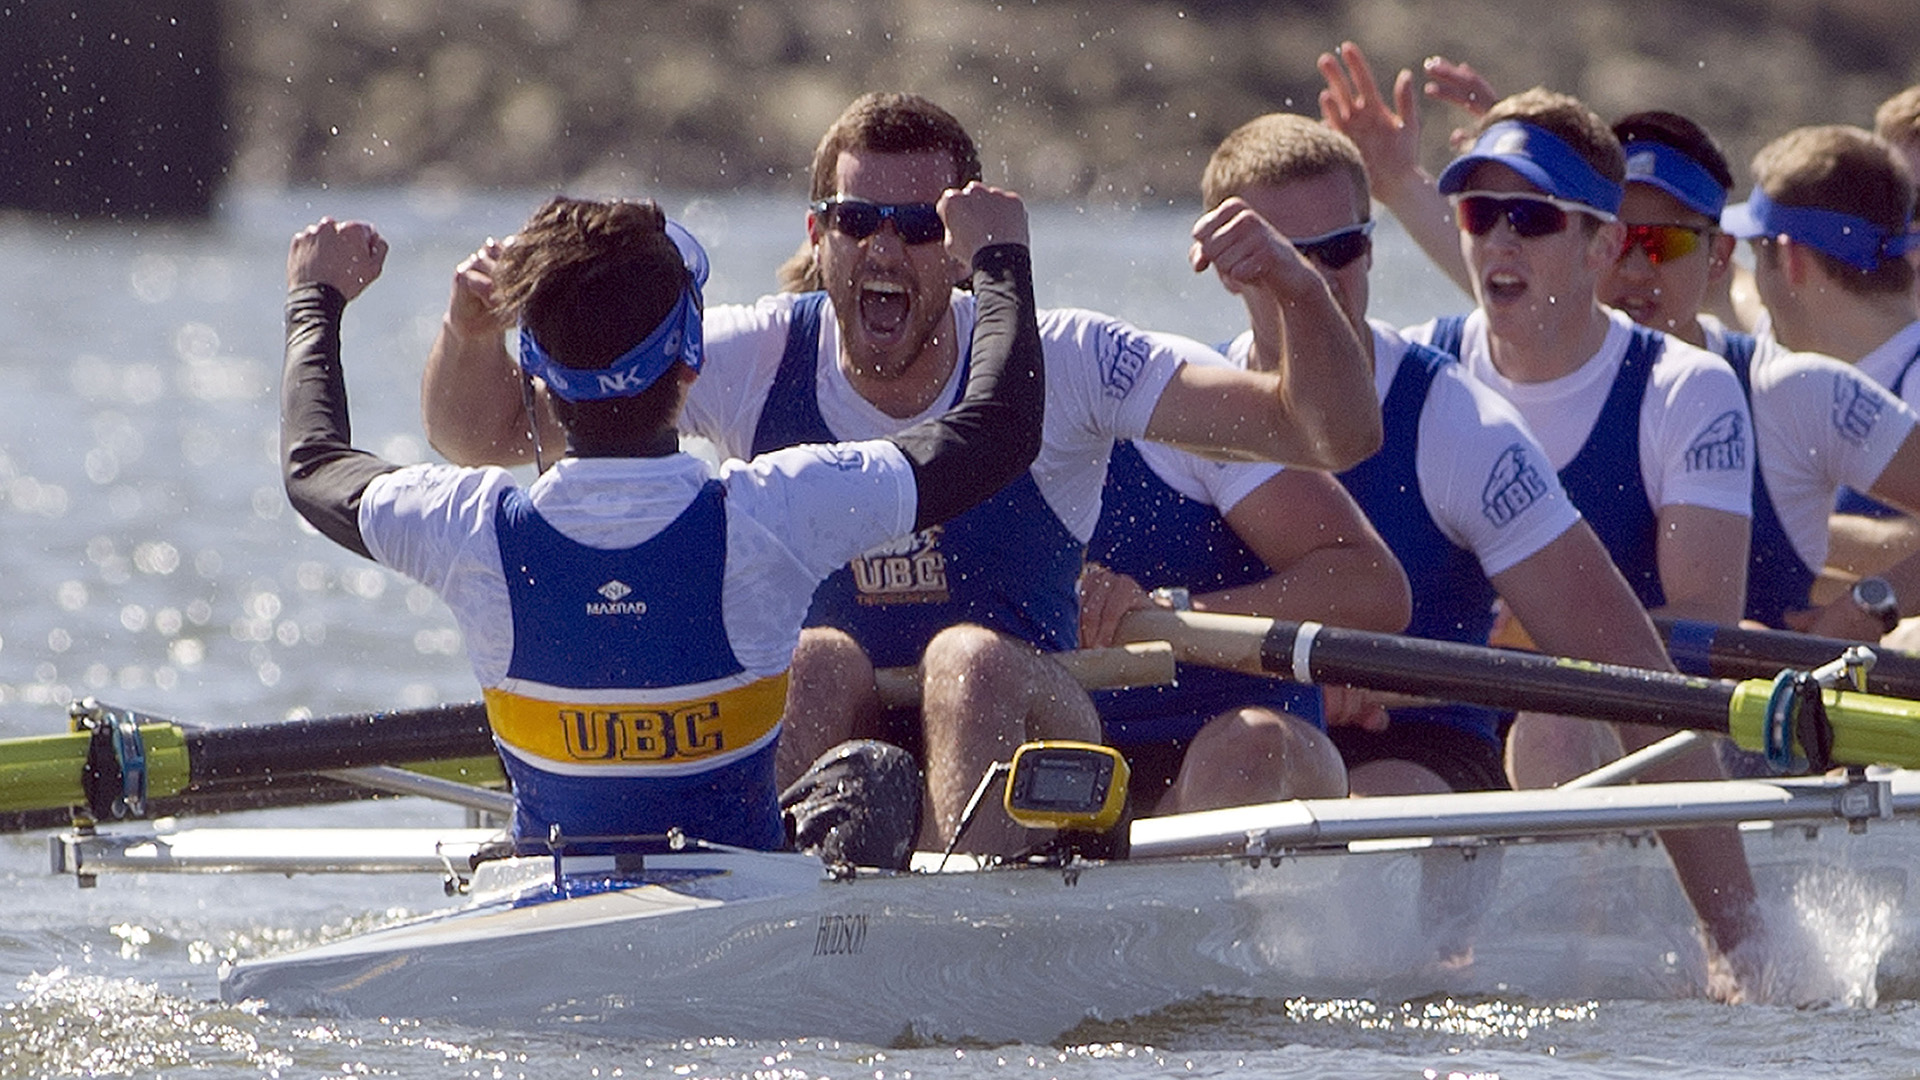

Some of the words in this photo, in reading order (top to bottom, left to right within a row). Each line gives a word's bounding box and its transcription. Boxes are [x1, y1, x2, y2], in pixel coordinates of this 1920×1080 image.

[598, 364, 643, 394] NK
[1482, 464, 1548, 528] UBC
[851, 550, 950, 594] UBC
[559, 701, 724, 760] UBC
[813, 913, 868, 956] HUDSON
